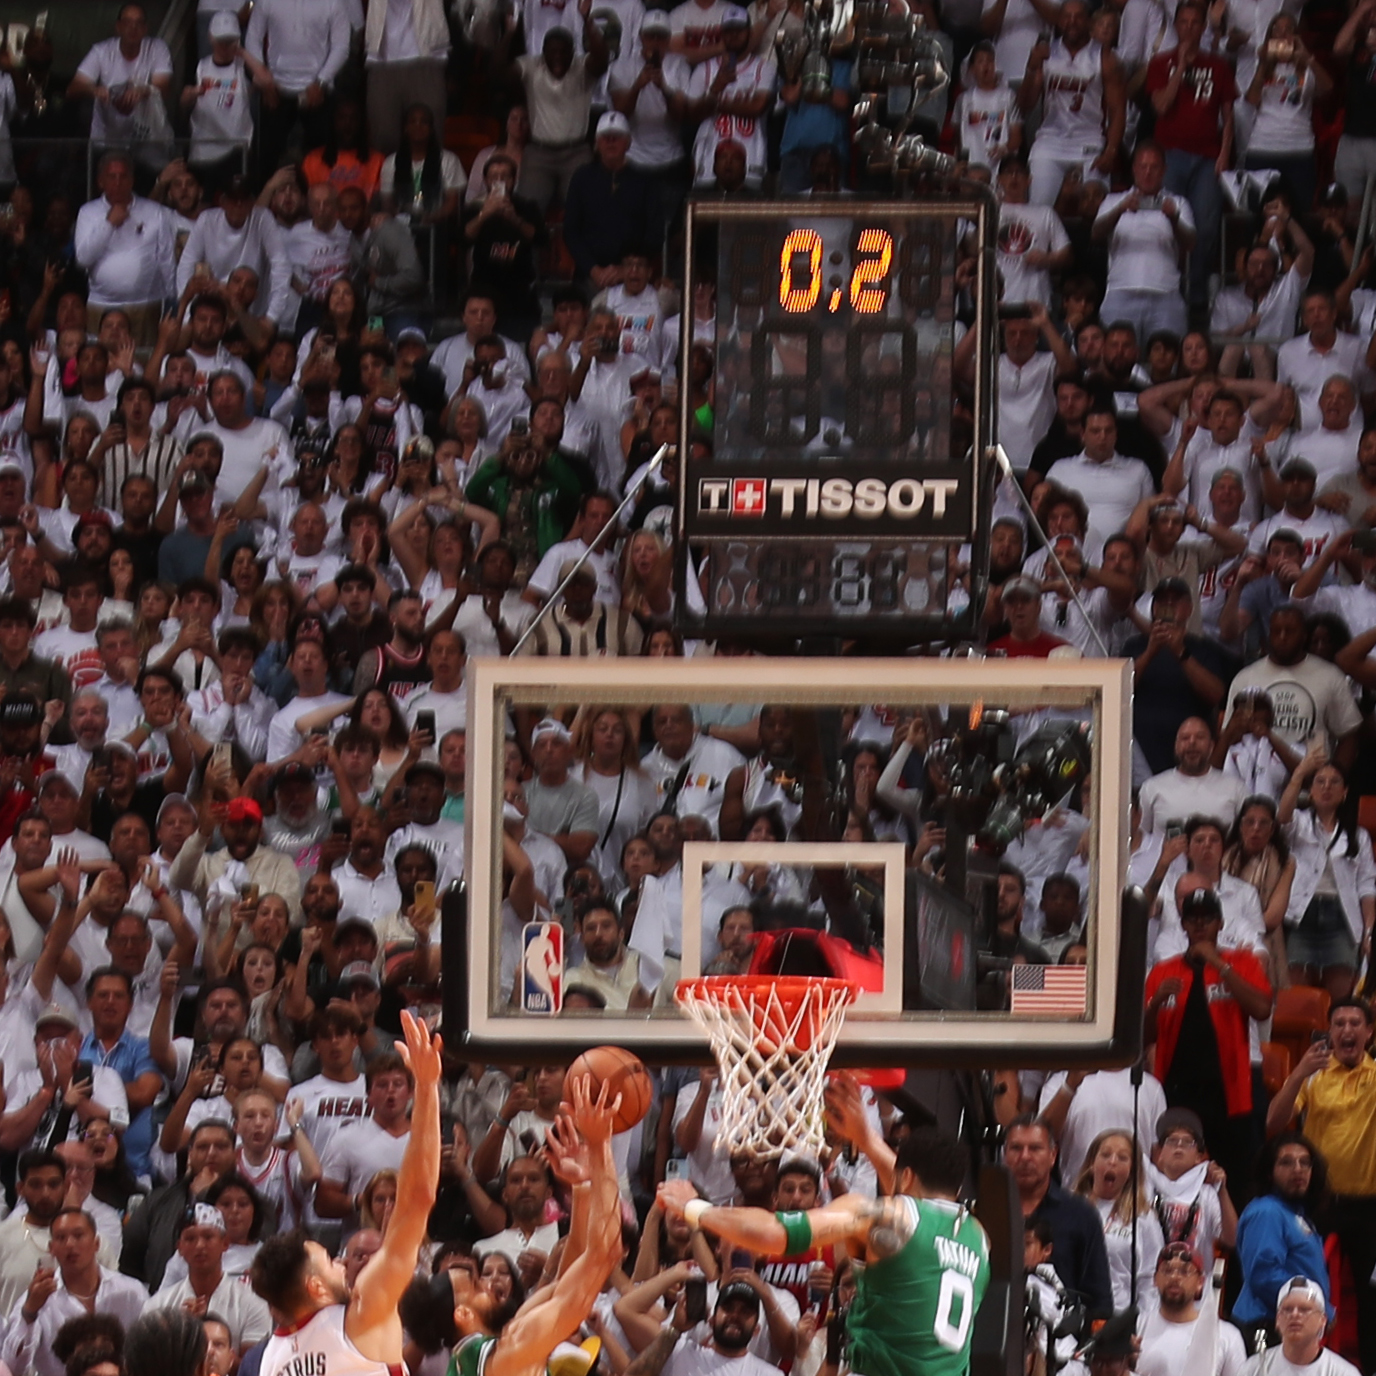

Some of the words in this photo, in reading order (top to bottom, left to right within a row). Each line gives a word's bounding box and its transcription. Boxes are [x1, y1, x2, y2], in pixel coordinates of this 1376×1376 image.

[769, 477, 959, 521] TISSOT
[527, 992, 548, 1010] NBA
[933, 1267, 975, 1354] 0
